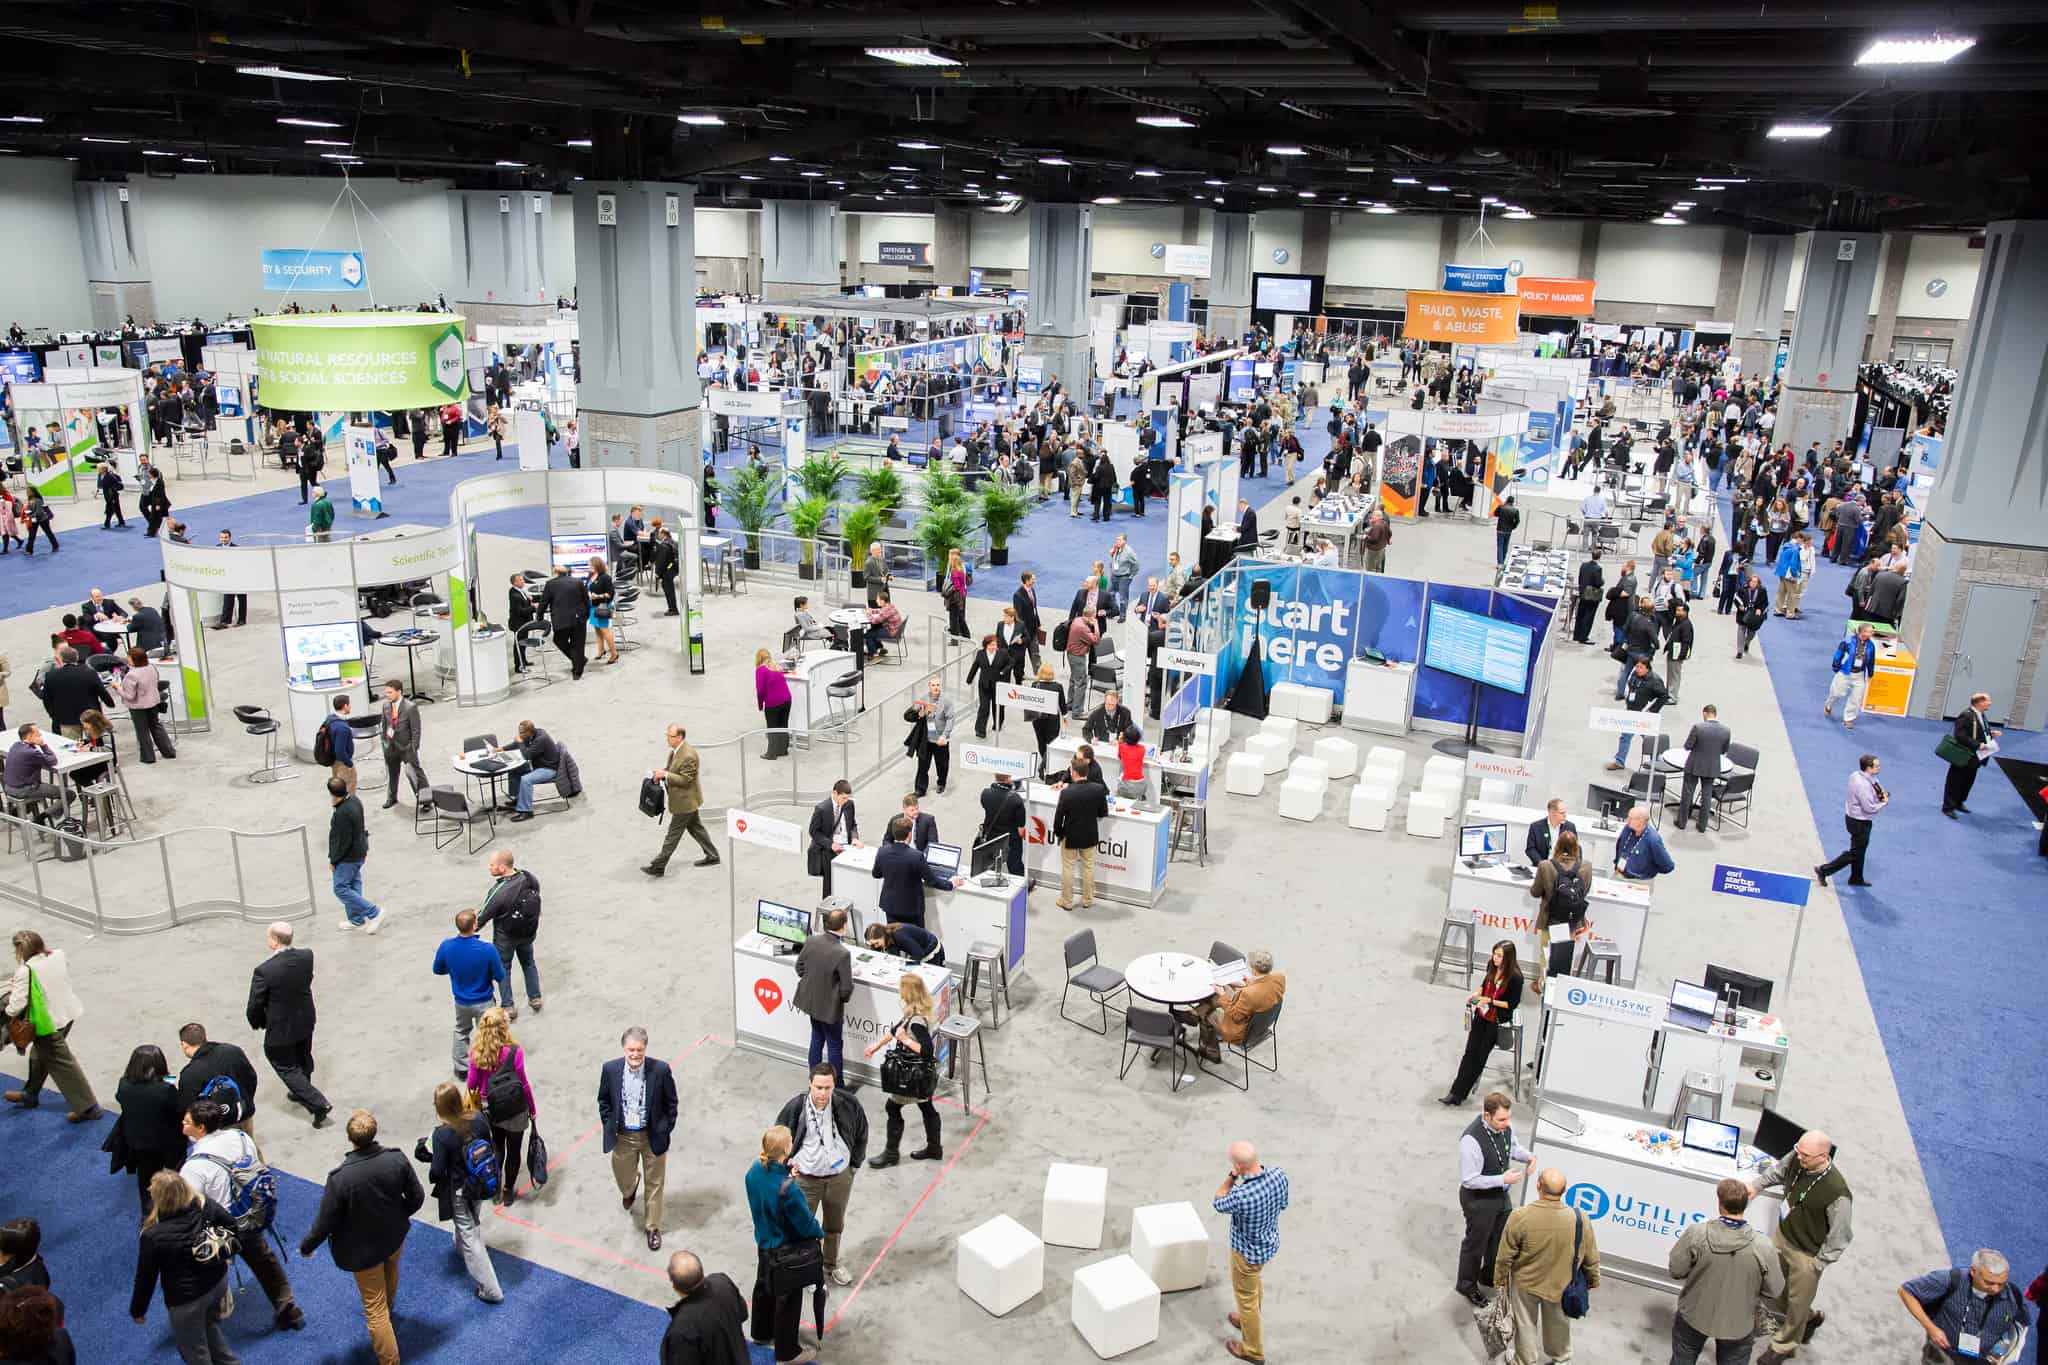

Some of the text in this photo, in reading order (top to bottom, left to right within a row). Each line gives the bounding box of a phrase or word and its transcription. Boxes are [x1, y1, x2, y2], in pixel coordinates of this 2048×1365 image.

[283, 264, 332, 275] SECURITY
[1552, 293, 1585, 303] MAKING
[1419, 304, 1503, 319] FRAUD, WASTE
[1432, 322, 1486, 333] & ABUSE
[267, 352, 321, 367] NATURAL
[327, 352, 417, 366] RESOURCES
[279, 371, 329, 384] SOCIAL
[333, 371, 408, 384] SCIENCES
[1243, 592, 1350, 636] start
[1241, 623, 1344, 672] here
[1726, 870, 1743, 878] esri
[1724, 882, 1761, 894] program
[1725, 876, 1755, 887] startup
[1615, 1193, 1707, 1226] UTILIS
[1612, 1213, 1670, 1236] MOBILE
